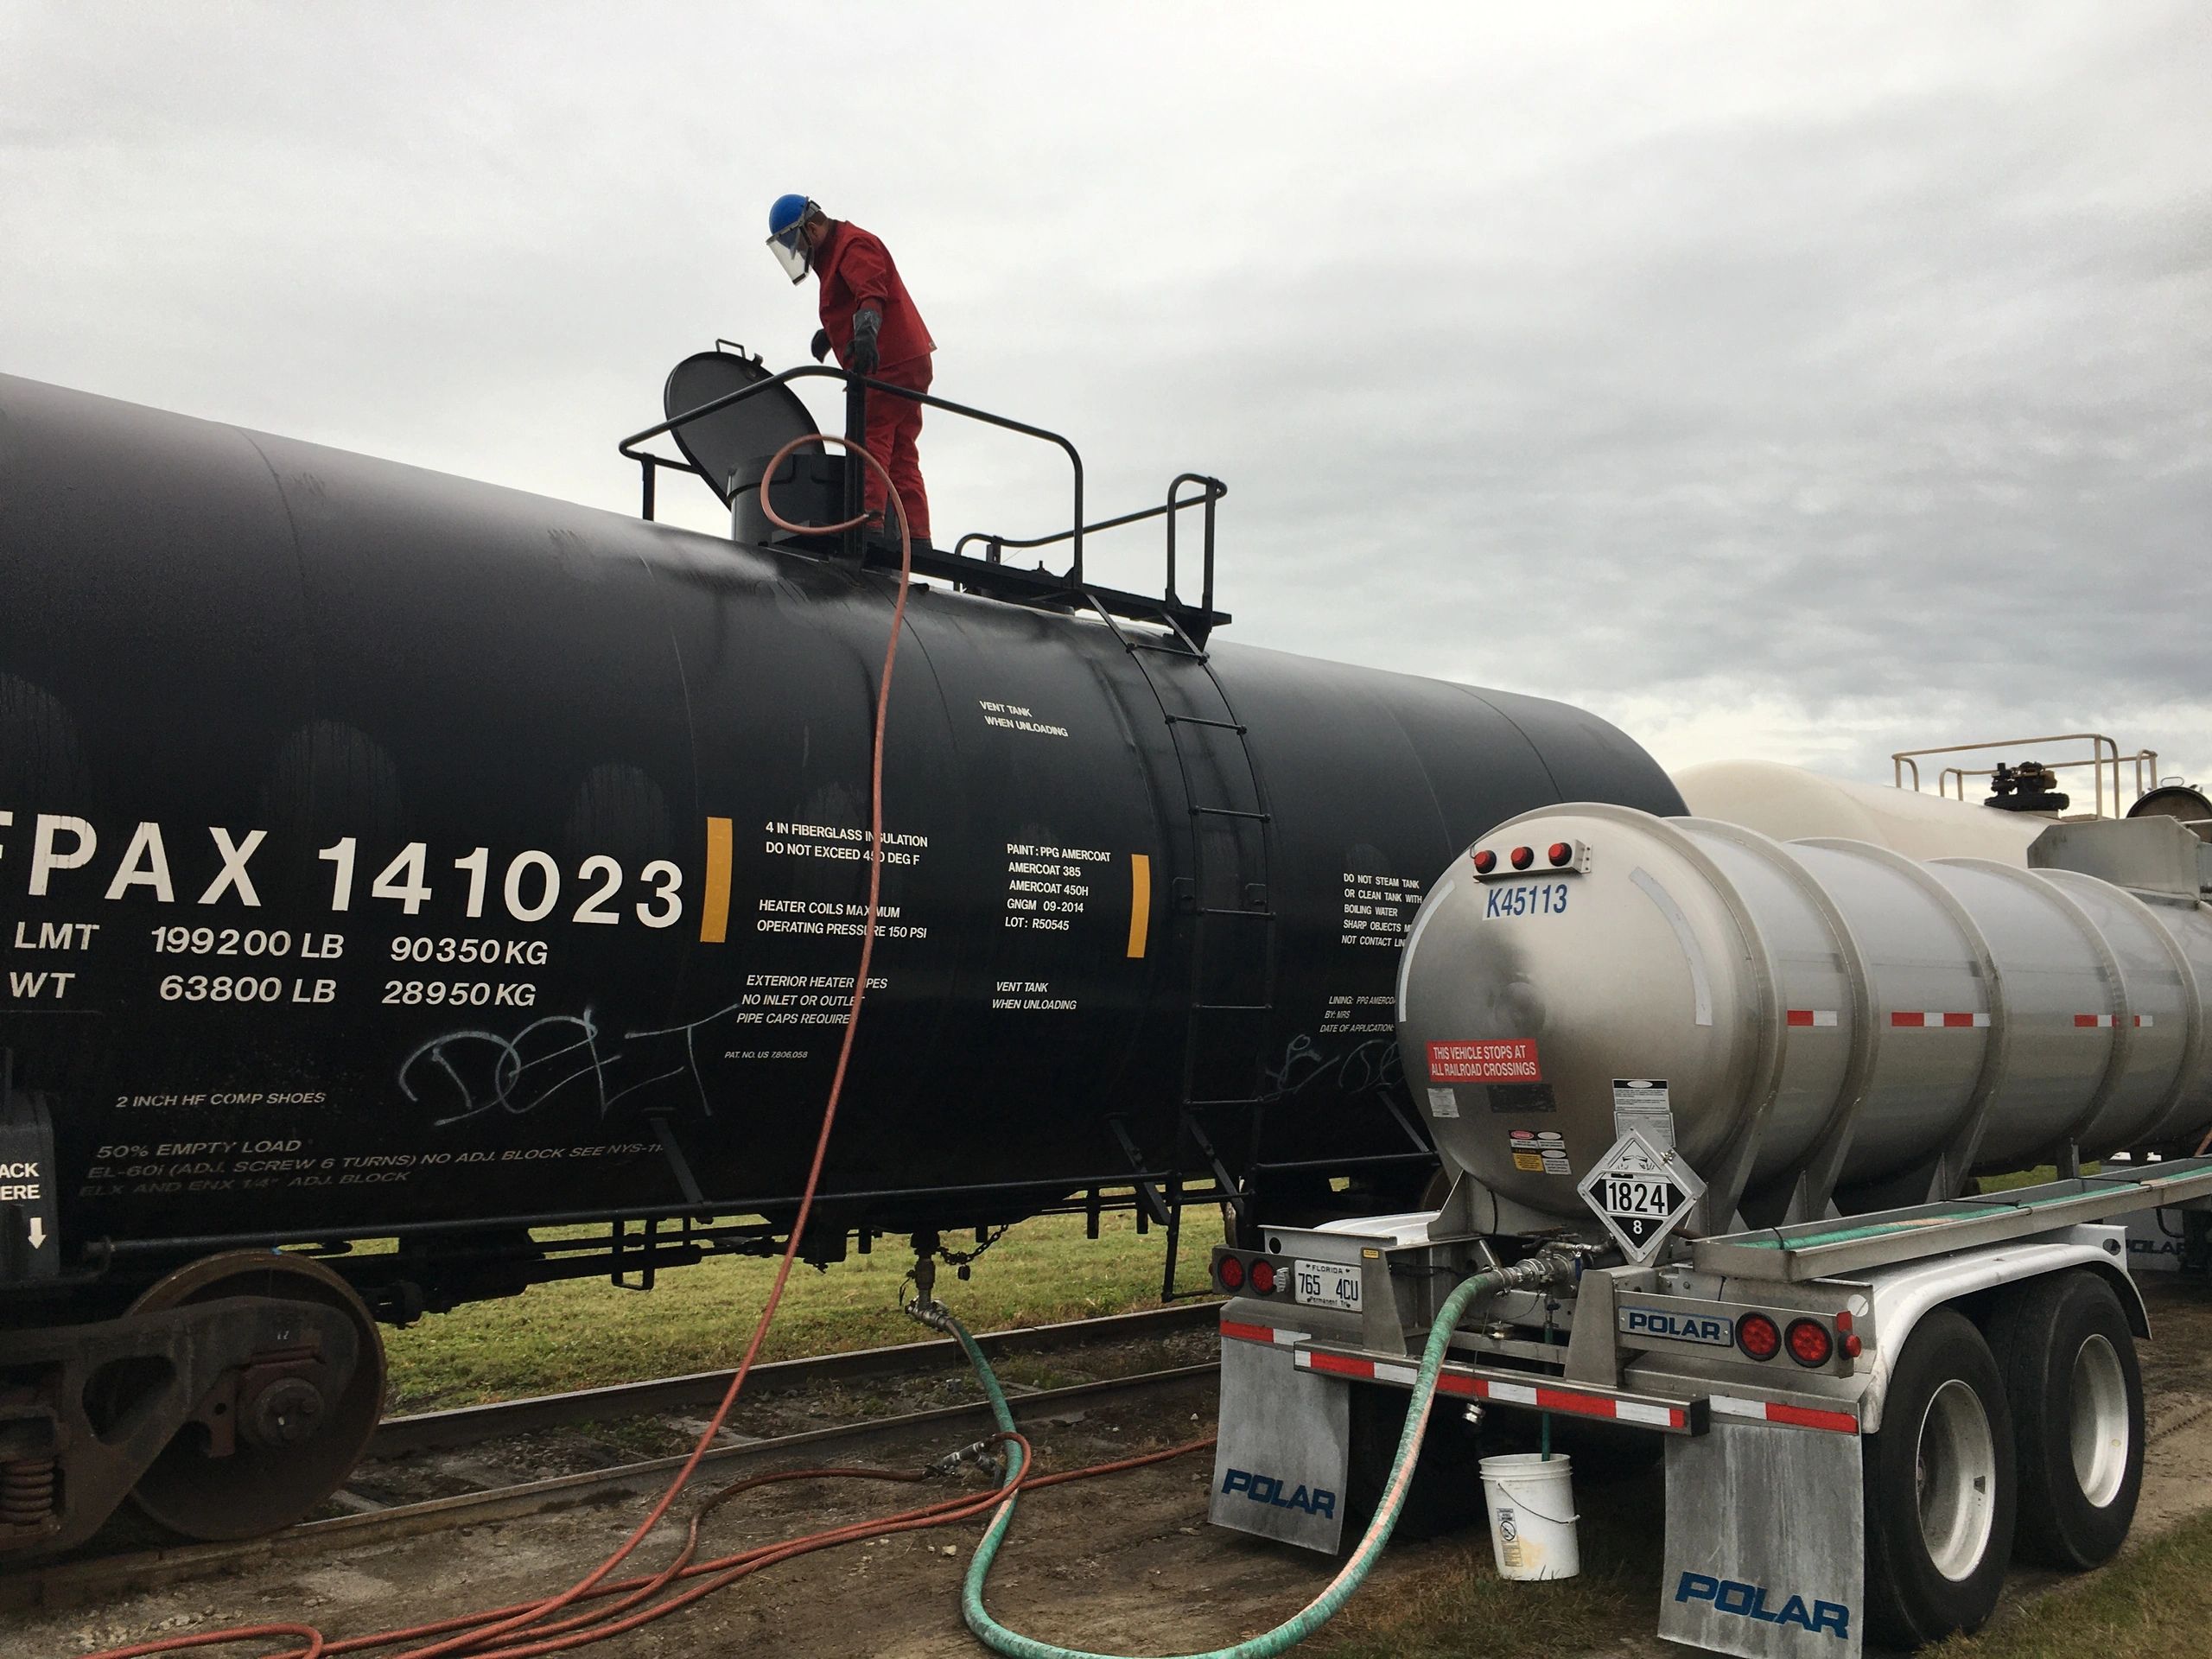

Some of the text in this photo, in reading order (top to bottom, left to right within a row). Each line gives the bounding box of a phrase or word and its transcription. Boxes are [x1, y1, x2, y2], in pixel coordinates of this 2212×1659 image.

[979, 700, 1032, 717] VENT TANK
[984, 715, 1069, 737] WHEN UNLOADING
[766, 821, 774, 833] 4
[777, 823, 789, 835] IN
[791, 823, 862, 842] FIBERGLASS
[766, 842, 784, 854] DO
[786, 843, 812, 856] NOT
[814, 846, 861, 861] EXCEED
[887, 853, 912, 864] DEG
[912, 855, 920, 865] F
[1039, 846, 1059, 858] PPG
[1061, 849, 1111, 862] AMERCOAT
[0, 809, 683, 928] PAX 141023
[1008, 862, 1081, 877] AMERCOAT 385
[1009, 880, 1089, 896] AMERCOAT 450H
[1344, 873, 1420, 888] DO NOT STEAM TANK
[1344, 888, 1422, 904] OR CLEAN TANK WITH
[1486, 884, 1567, 918] K45113
[759, 899, 900, 918] HEATER COILS MAXMUM
[1007, 898, 1037, 911] GNGM
[1344, 905, 1398, 917] BOILING WATER
[757, 919, 823, 934] OPERATING
[888, 926, 907, 938] 150
[909, 927, 927, 938] PSI
[1005, 917, 1070, 931] LOT: R50545
[1343, 919, 1368, 930] SHARP
[1370, 922, 1402, 932] OBJECTS
[14, 921, 100, 950] LMT
[150, 926, 292, 957] 199200
[300, 932, 345, 959] LB
[1341, 935, 1406, 947] NOT CONTACT LIN
[9, 971, 76, 999] WT
[159, 975, 283, 1002] 63800
[291, 979, 337, 1003] LB
[747, 975, 889, 988] EXTERIOR HEATER IPES
[996, 982, 1049, 994] VENT TANK
[741, 994, 865, 1007] NO INLET OR OUTLE
[993, 999, 1077, 1011] WHEN UNLOADING
[1328, 995, 1396, 1006] LINING: PPG AMERCO
[736, 1013, 849, 1025] PIPE CAPS REQUIRE
[1319, 1024, 1338, 1033] DATE
[1338, 1024, 1350, 1033] OF
[1433, 1045, 1526, 1059] THIS VEHICLE STOPS AT
[1431, 1062, 1536, 1077] ALL RAILROAD CROSSINGS
[116, 1092, 326, 1108] 2 INCH HF COMP SHOES
[96, 1140, 302, 1159] 50% EMPTY LOAD
[234, 1160, 316, 1173] SCREW
[321, 1158, 334, 1170] 6
[342, 1154, 416, 1169] TURNS)
[420, 1154, 451, 1166] NO
[500, 1147, 565, 1161] BLOCK
[568, 1146, 607, 1158] SEE
[0, 1162, 40, 1179] ACK
[339, 1170, 410, 1184] BLOCK
[0, 1185, 41, 1201] ERE
[1608, 1183, 1665, 1213] 1824
[1633, 1220, 1643, 1235] 8
[1313, 1264, 1344, 1274] FLORIDA
[1298, 1273, 1358, 1301] 765 4CU
[1629, 1313, 1720, 1340] POLAR
[1222, 1468, 1336, 1519] POLAR
[1675, 1572, 1850, 1639] POLAR
